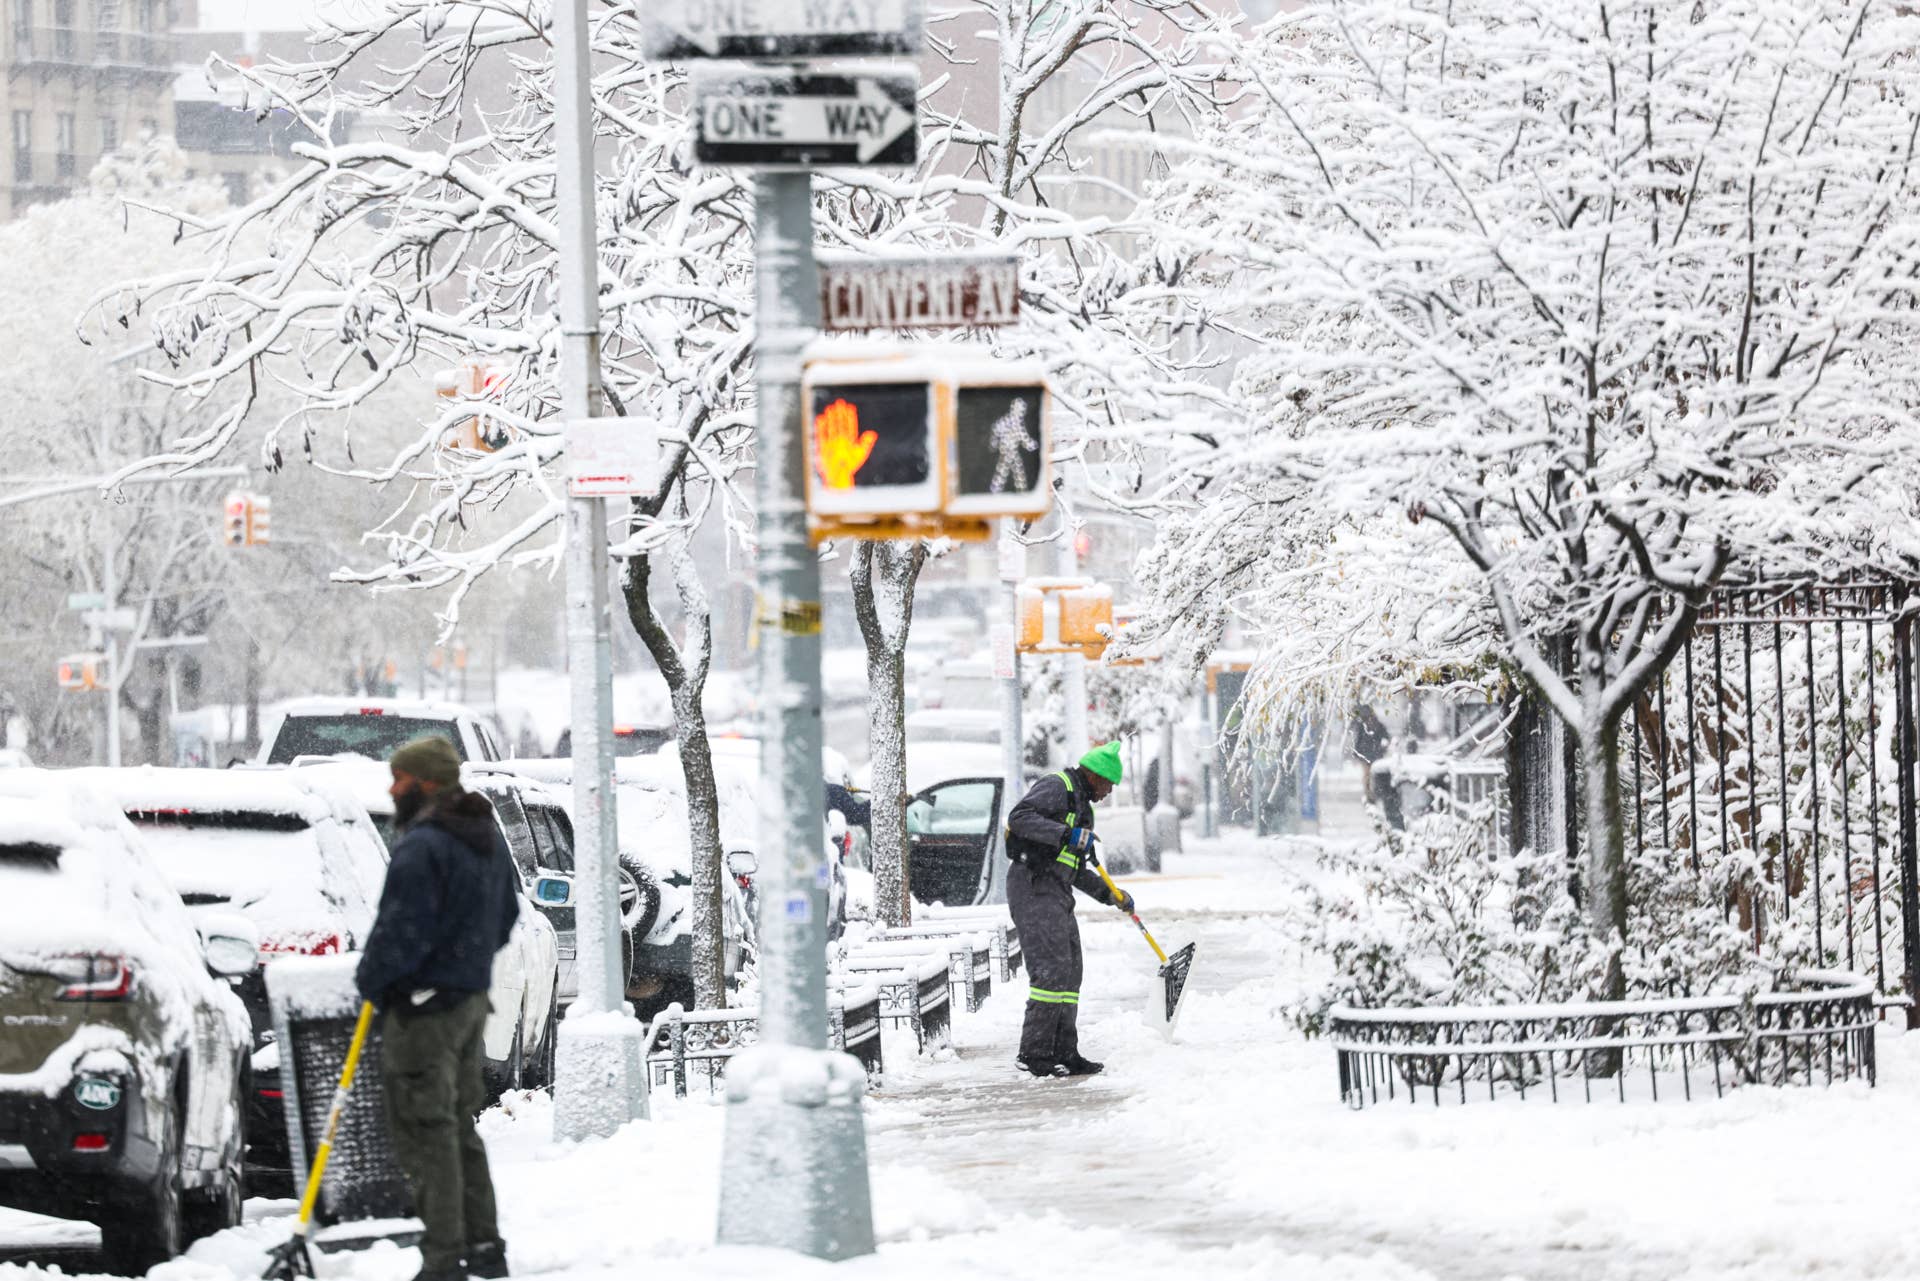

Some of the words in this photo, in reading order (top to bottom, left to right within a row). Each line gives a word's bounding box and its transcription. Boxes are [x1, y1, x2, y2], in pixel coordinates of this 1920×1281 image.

[685, 0, 760, 32] ONE
[806, 0, 880, 28] WAY
[713, 102, 784, 137] ONE
[824, 104, 892, 137] WAY
[829, 271, 969, 327] CONVENT
